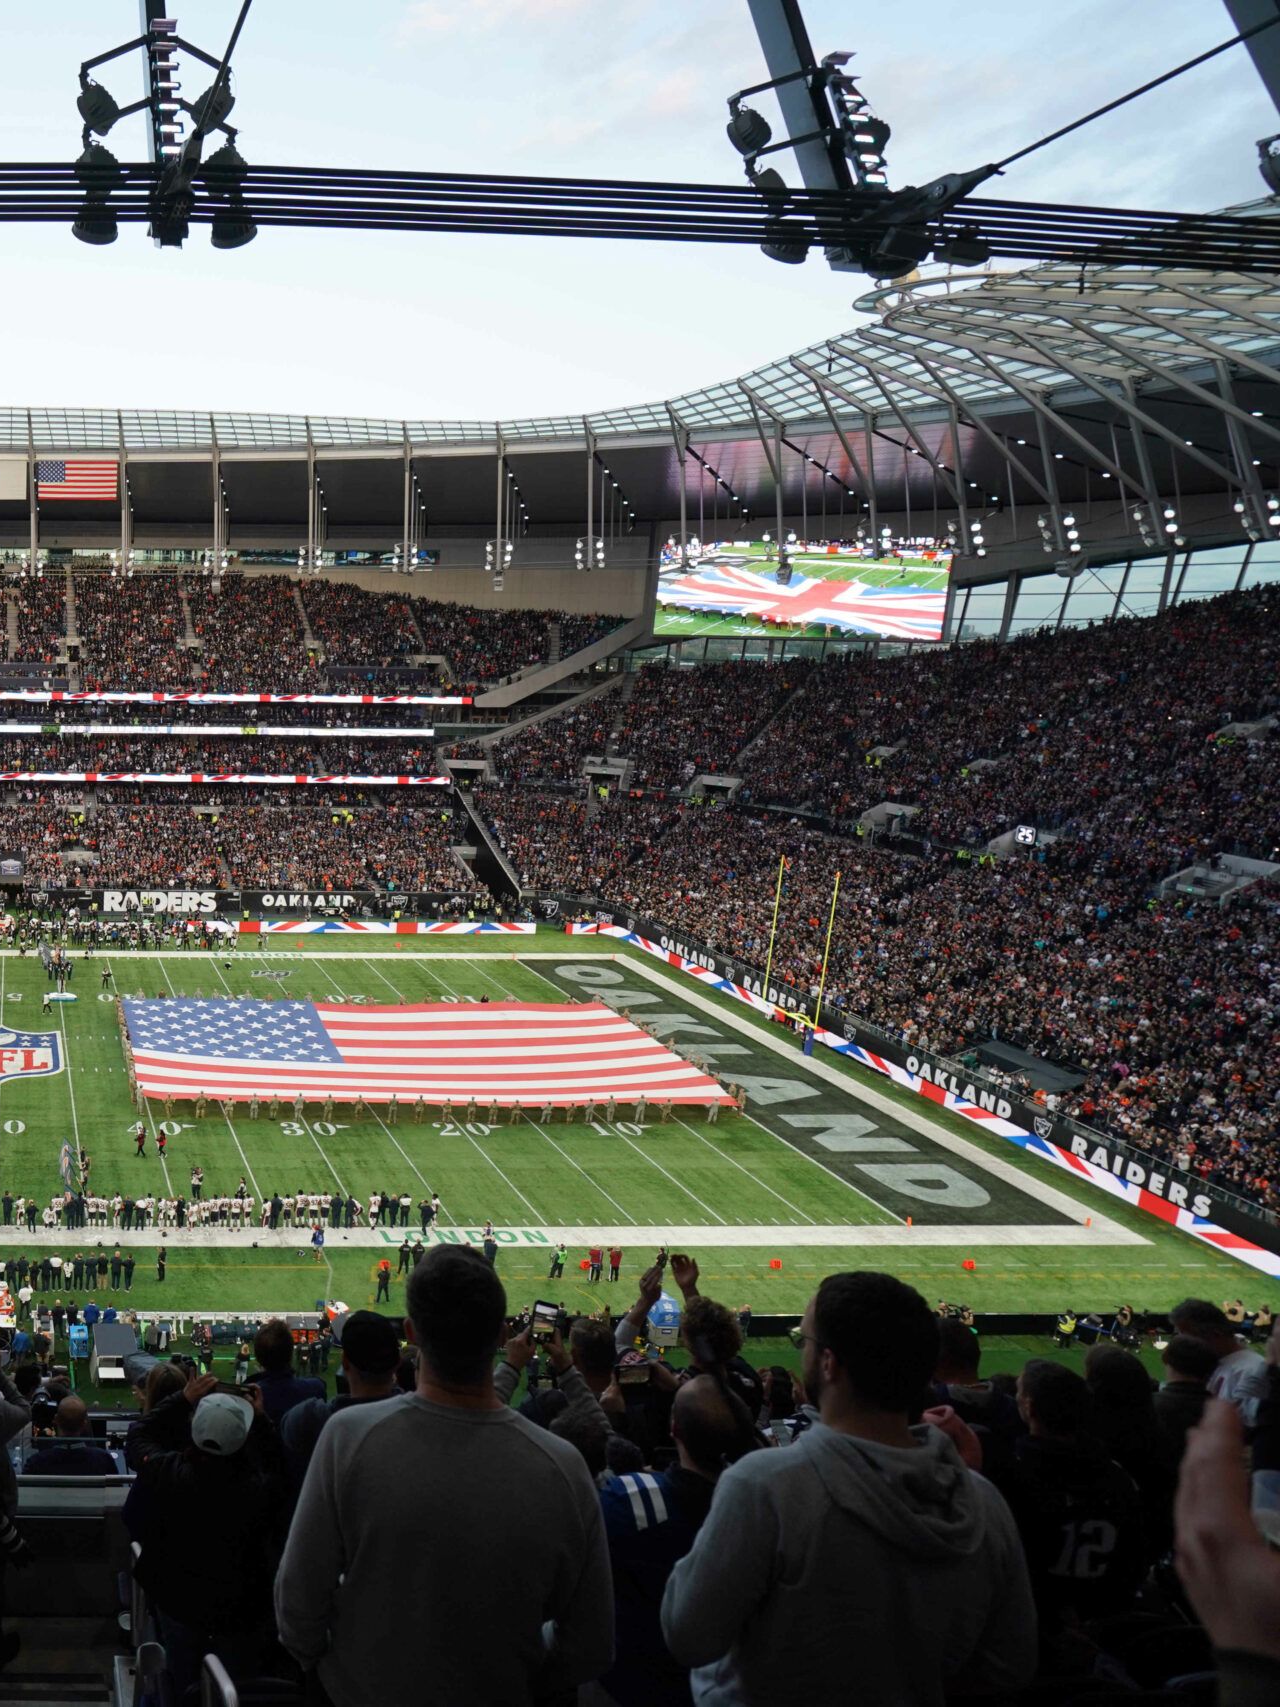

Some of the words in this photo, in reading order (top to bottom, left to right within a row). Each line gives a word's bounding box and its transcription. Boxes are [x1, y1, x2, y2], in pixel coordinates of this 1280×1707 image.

[1017, 827, 1033, 842] 25
[103, 891, 217, 912] RAIDERS
[262, 894, 357, 908] OAKLAND
[660, 935, 716, 972] OAKLAND
[743, 975, 807, 1014] RADERS
[906, 1056, 1012, 1119] OAKLAND
[1071, 1135, 1212, 1218] RAIDERS
[379, 1230, 549, 1244] LONDON
[1047, 1519, 1116, 1579] 12
